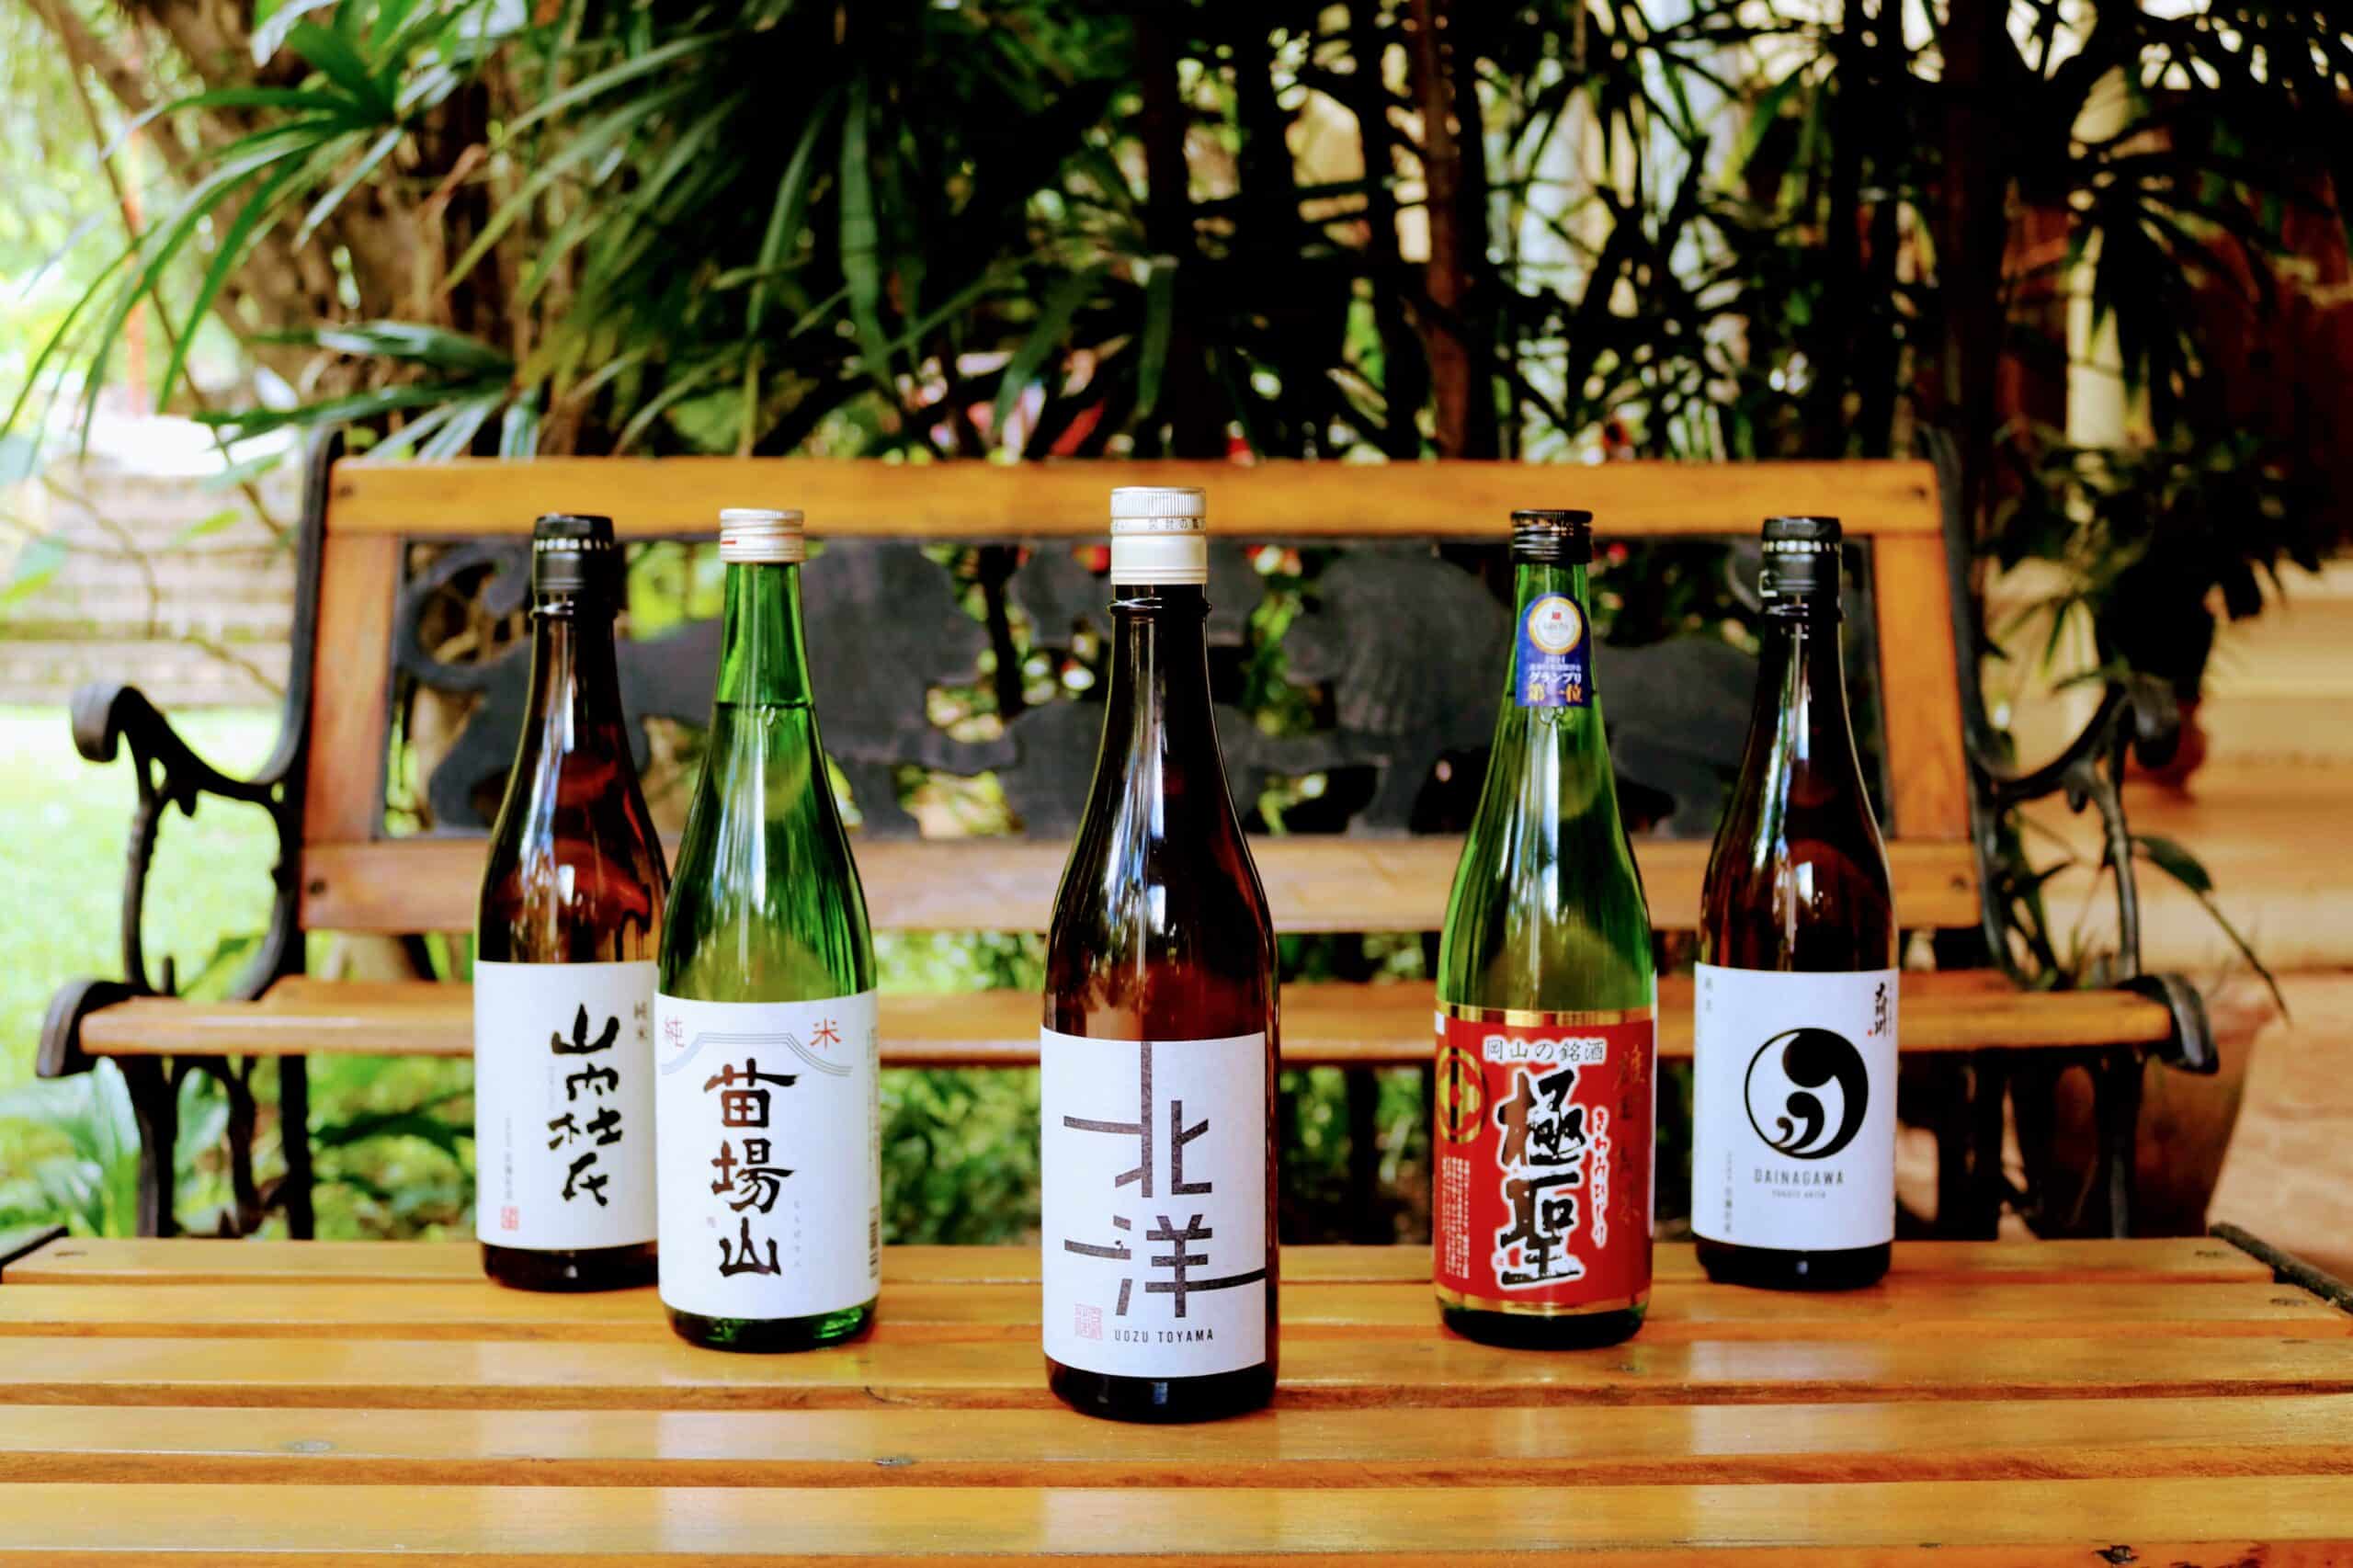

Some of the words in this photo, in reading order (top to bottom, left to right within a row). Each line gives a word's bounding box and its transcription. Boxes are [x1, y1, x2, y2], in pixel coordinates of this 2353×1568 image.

[810, 1017, 841, 1050] 米
[1485, 1039, 1604, 1062] 岡山の銘酒
[703, 1057, 798, 1278] 苗場山
[1063, 1040, 1267, 1318] 北洋
[1497, 1069, 1588, 1285] 極聖
[1754, 1168, 1844, 1185] DAINAGAWA
[1114, 1330, 1149, 1343] UOZU
[1157, 1328, 1213, 1343] TOYAMA
